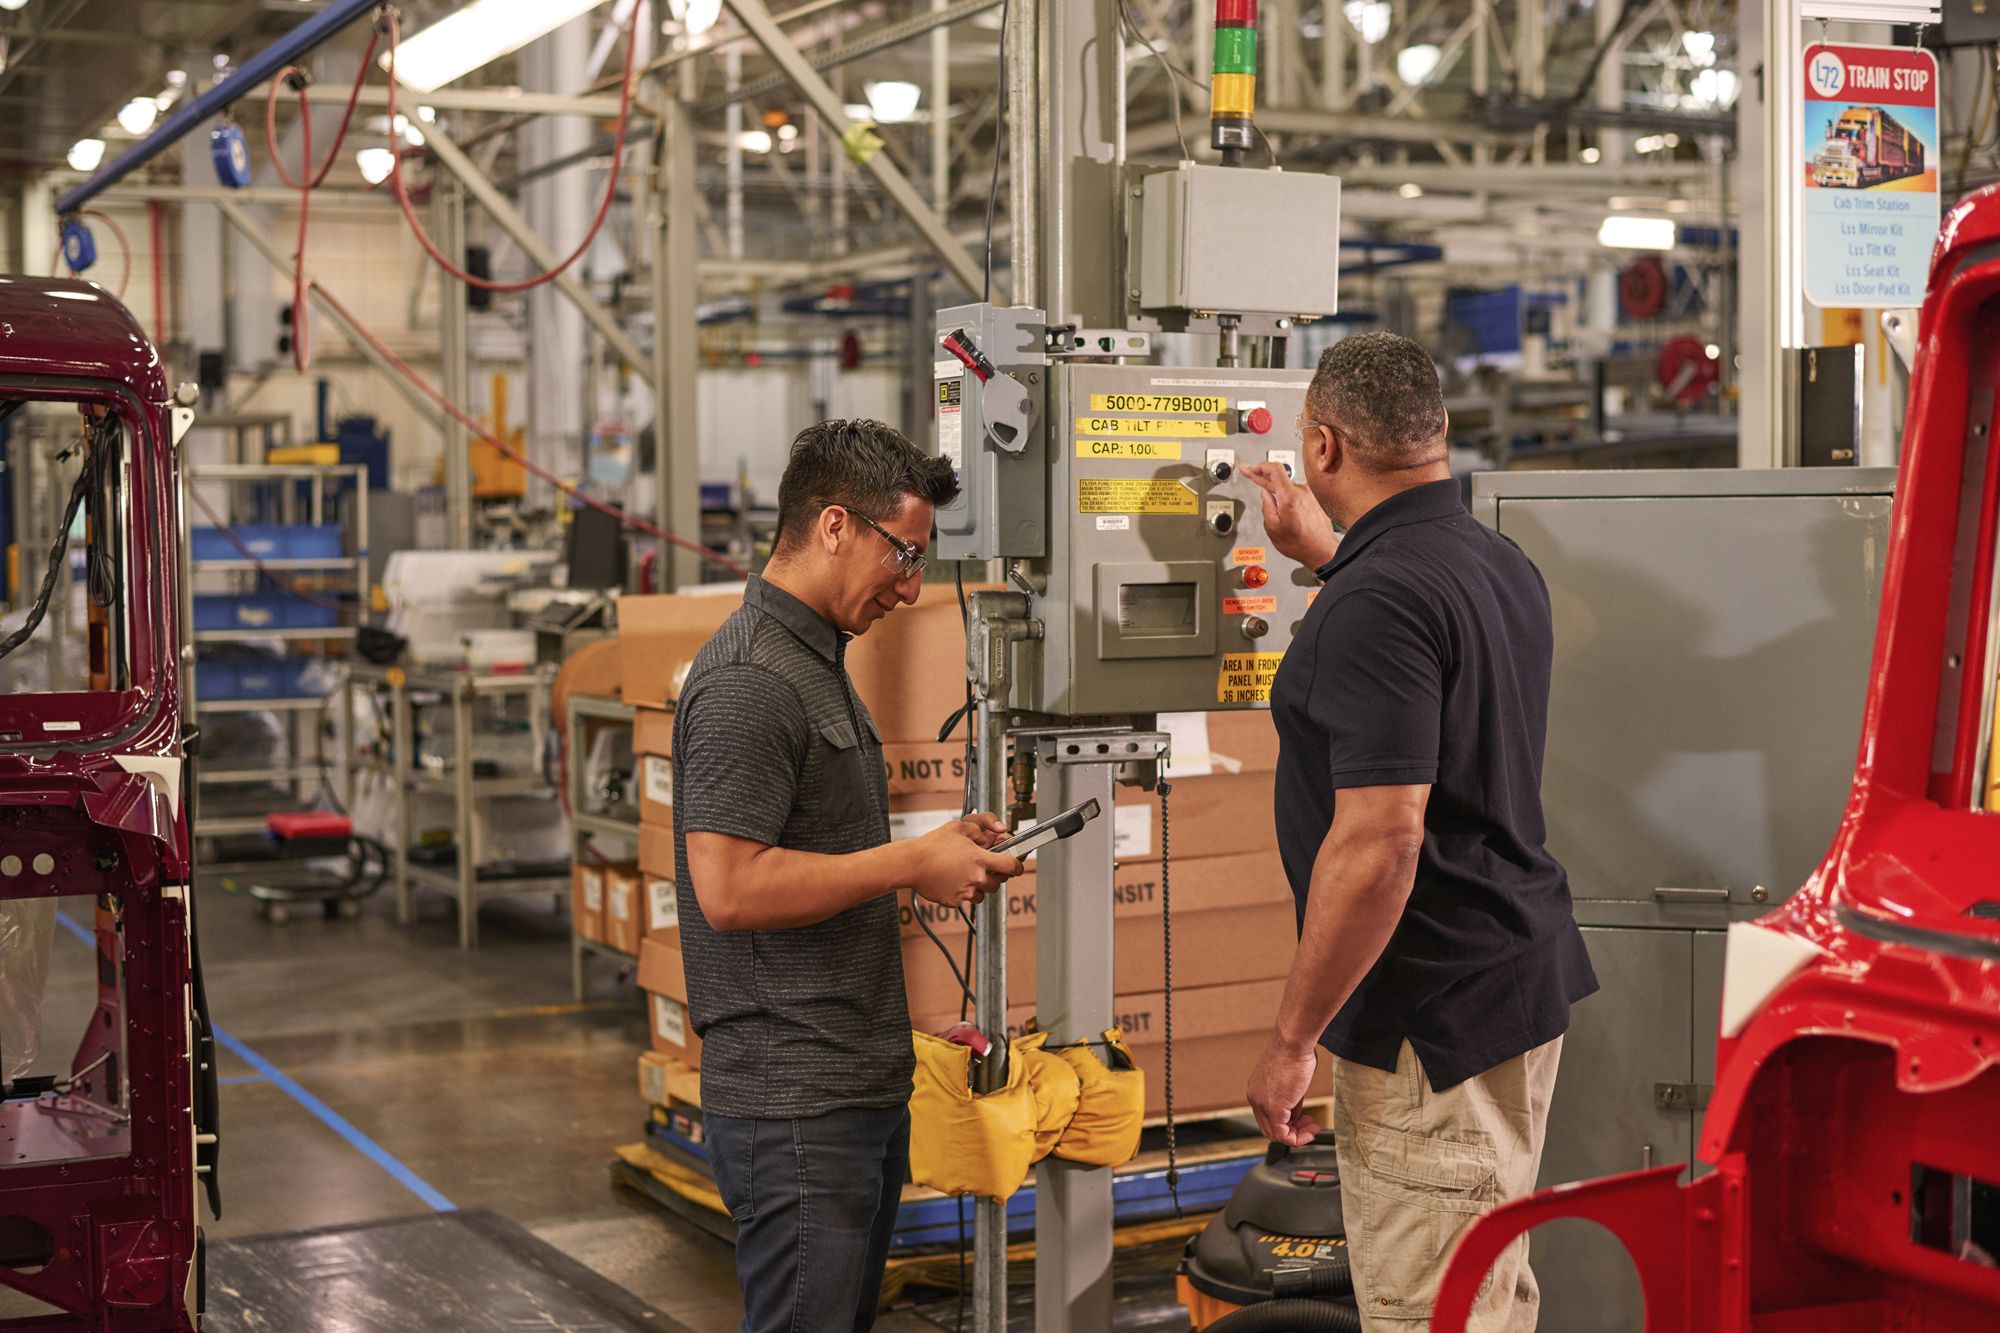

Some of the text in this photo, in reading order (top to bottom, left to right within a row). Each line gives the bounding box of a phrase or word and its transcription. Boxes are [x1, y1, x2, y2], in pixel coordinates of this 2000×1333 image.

[1816, 60, 1929, 92] L72 TRAIN STOP
[1834, 196, 1910, 212] Cab Trim Station
[1859, 222, 1888, 235] Mirror
[1890, 223, 1903, 236] Kit
[1866, 243, 1881, 256] Tilt
[1884, 244, 1896, 256] Kit
[1864, 264, 1884, 278] Seat
[1887, 264, 1900, 278] Kit
[1853, 282, 1875, 296] Door
[1878, 282, 1896, 296] Pad
[1898, 282, 1910, 296] Kit
[1106, 395, 1219, 412] 5000-779B001
[1091, 419, 1119, 431] CAB
[1224, 660, 1242, 671] AREA
[1246, 659, 1254, 671] IN
[1228, 675, 1252, 686] PANEL
[1224, 690, 1233, 702] 36
[1237, 690, 1264, 702] INCHES
[900, 760, 942, 780] NOT
[952, 756, 966, 777] S
[921, 905, 960, 922] NOT
[1114, 882, 1156, 904] NSIT
[1115, 1012, 1150, 1033] SIT
[1272, 1242, 1315, 1258] 4.0
